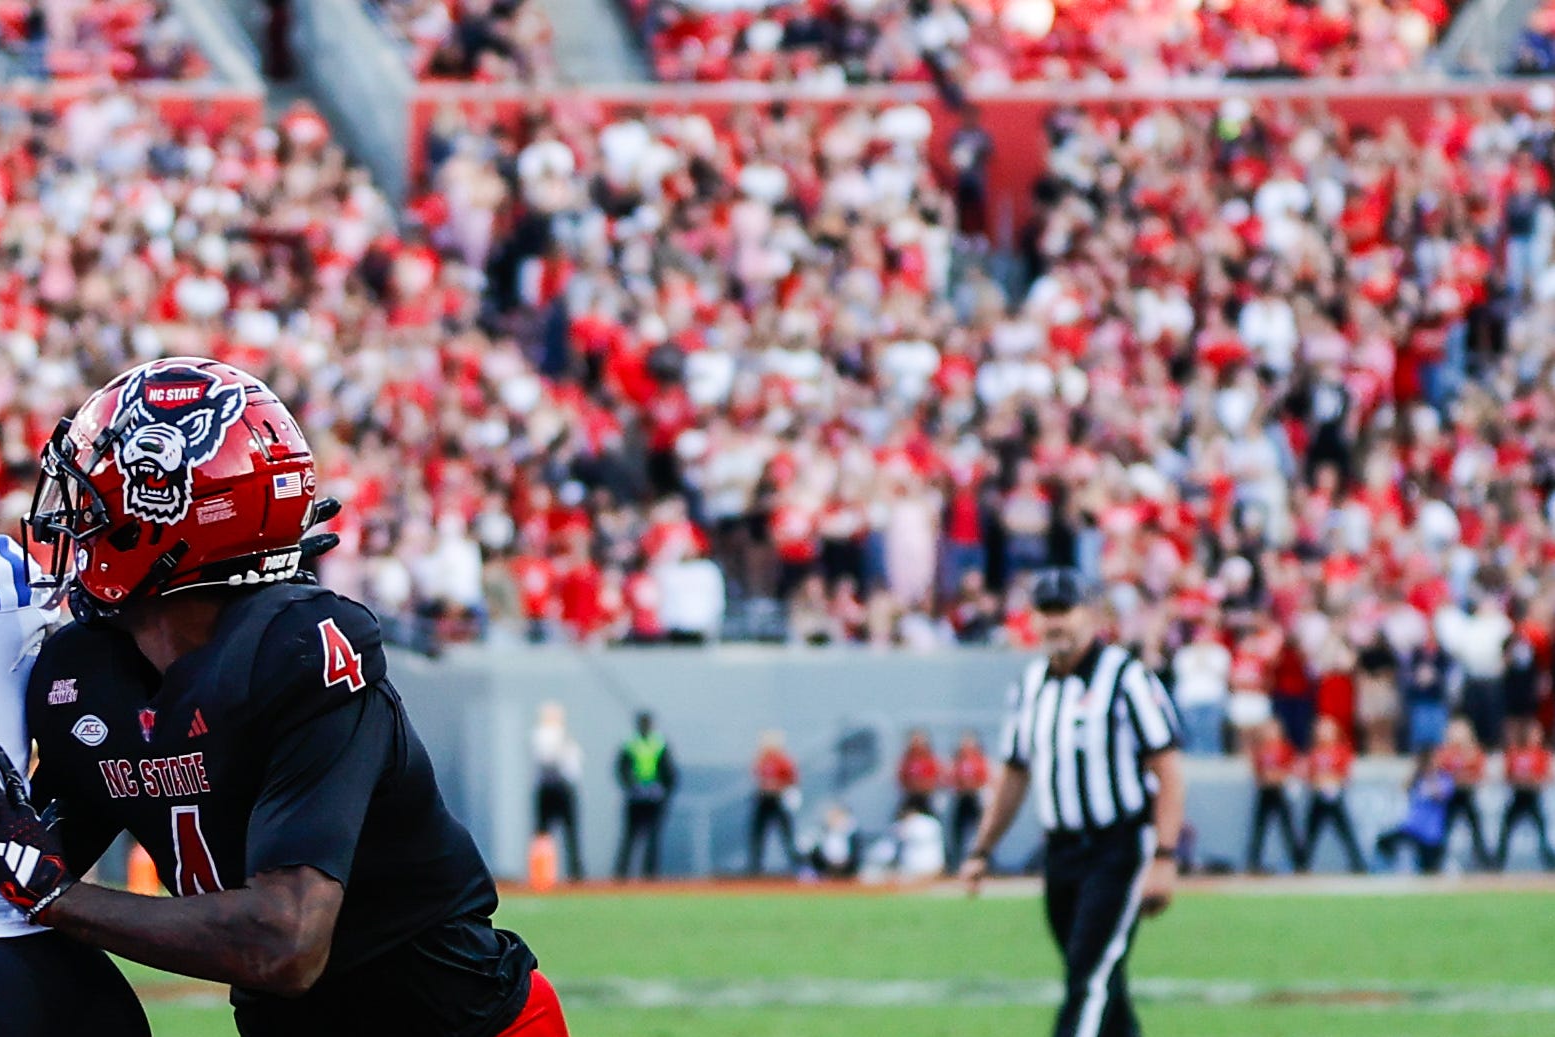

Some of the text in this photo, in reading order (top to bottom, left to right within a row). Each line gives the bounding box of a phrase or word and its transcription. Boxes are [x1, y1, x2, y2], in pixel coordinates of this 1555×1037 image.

[149, 387, 200, 401] NC STATE
[317, 617, 366, 692] 4
[81, 723, 101, 735] ACC
[99, 752, 211, 798] NC STATE
